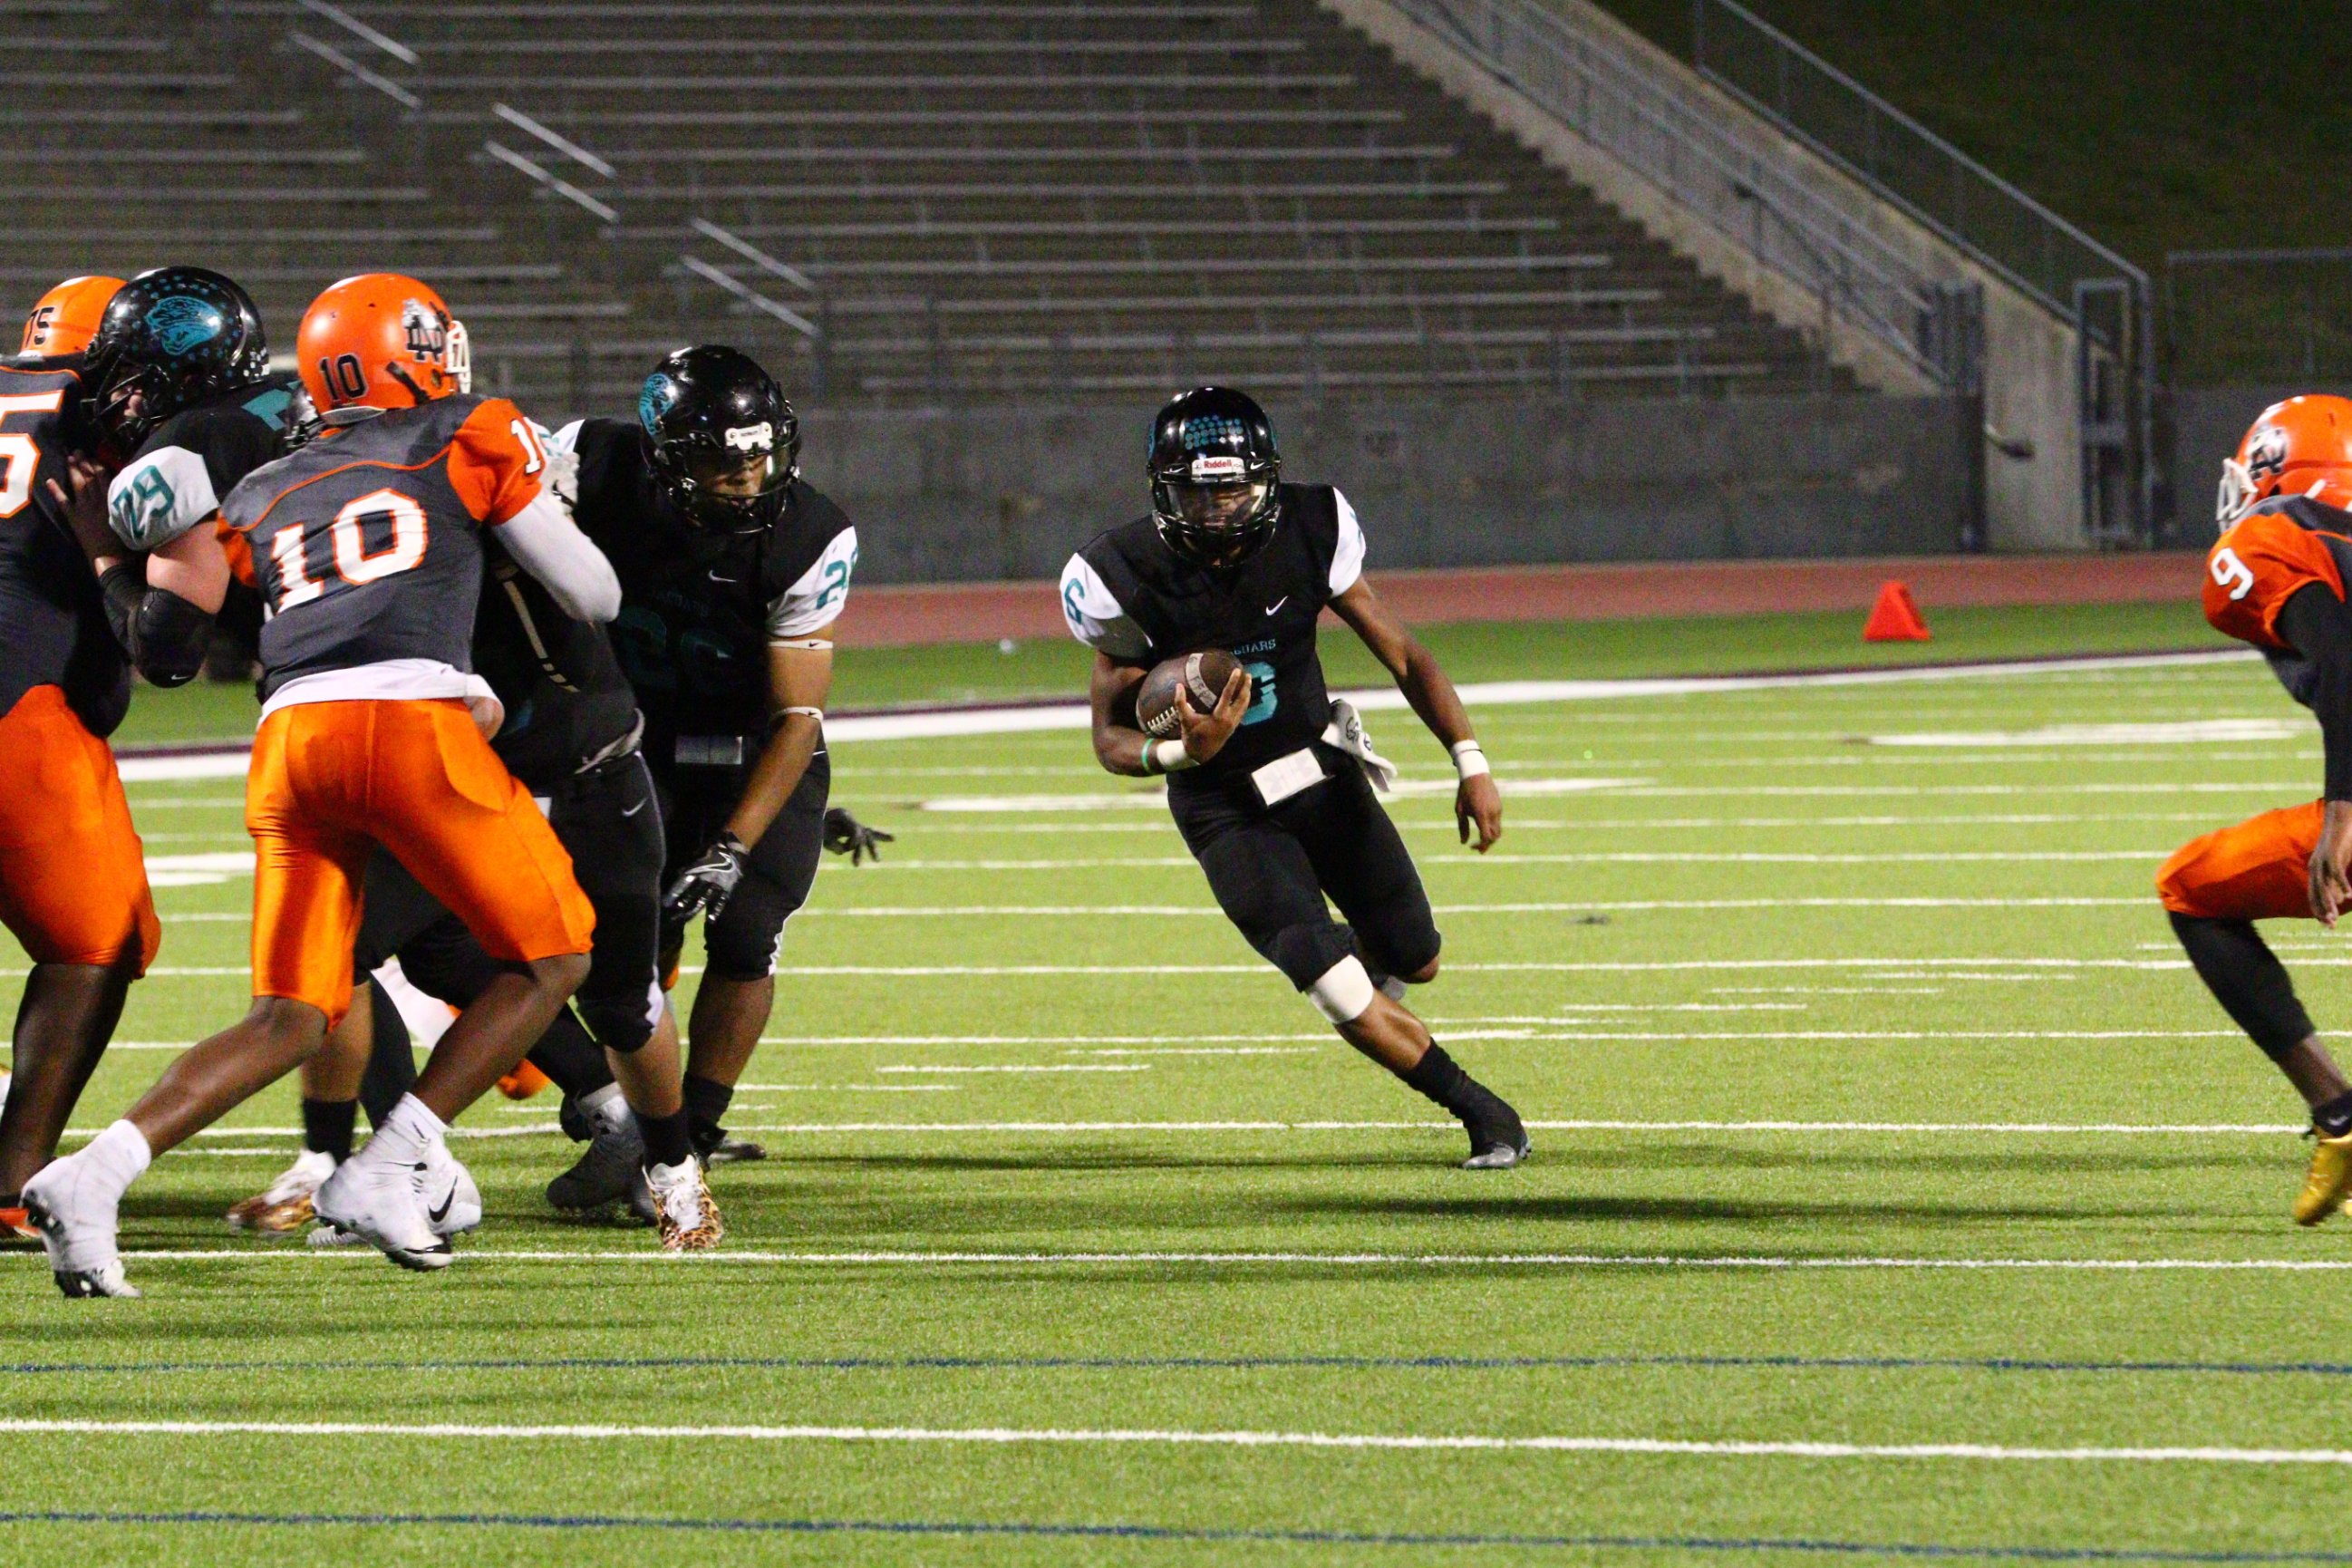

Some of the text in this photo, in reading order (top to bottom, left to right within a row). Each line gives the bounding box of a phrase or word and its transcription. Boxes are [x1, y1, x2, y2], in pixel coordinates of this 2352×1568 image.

[319, 353, 368, 402] 10
[510, 417, 547, 475] 1
[1204, 459, 1233, 469] Riddell
[272, 488, 429, 615] 10
[2211, 547, 2254, 601] 9
